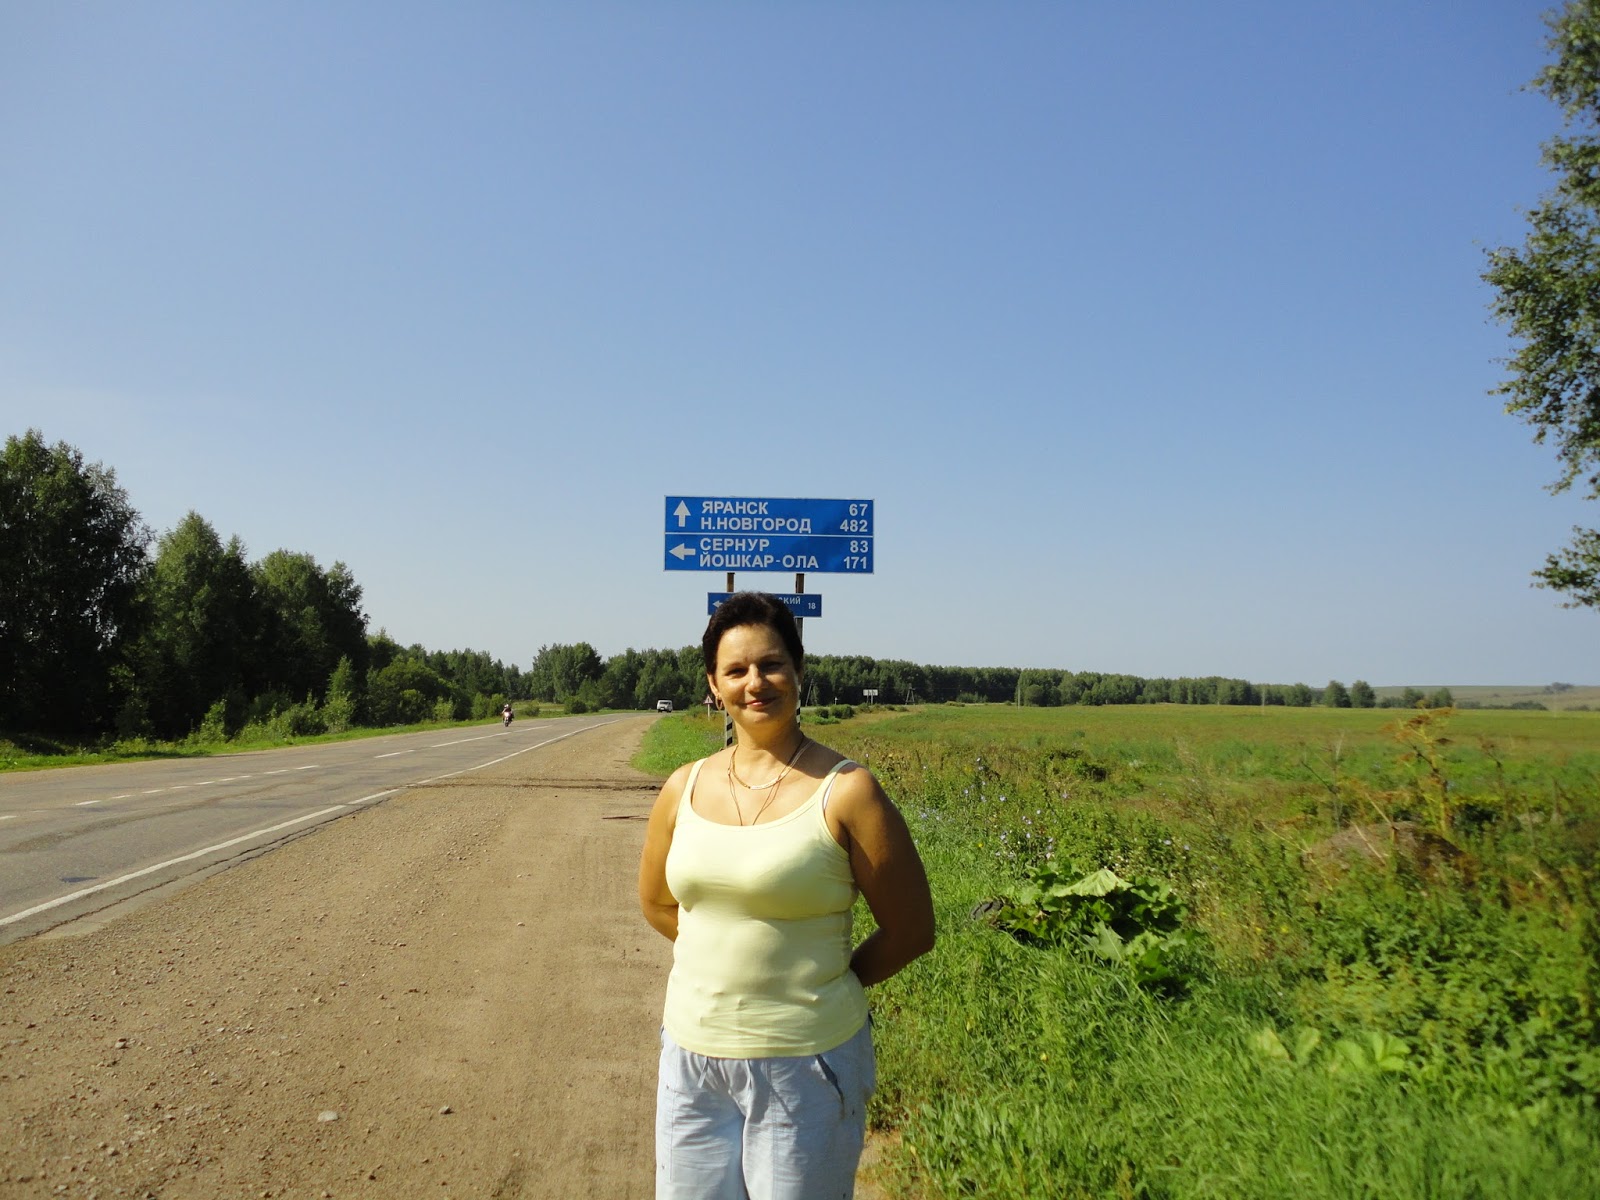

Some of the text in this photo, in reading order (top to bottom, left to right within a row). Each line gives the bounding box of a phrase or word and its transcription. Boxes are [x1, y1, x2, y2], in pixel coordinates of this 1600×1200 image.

[702, 501, 868, 516] ЯРАНСК 67
[701, 517, 868, 534] Н.НОВГОРОД 482
[700, 538, 869, 553] СЕРНУР 83
[699, 552, 867, 569] ЙОШКАР-ОЛА 171
[807, 602, 816, 610] 18
